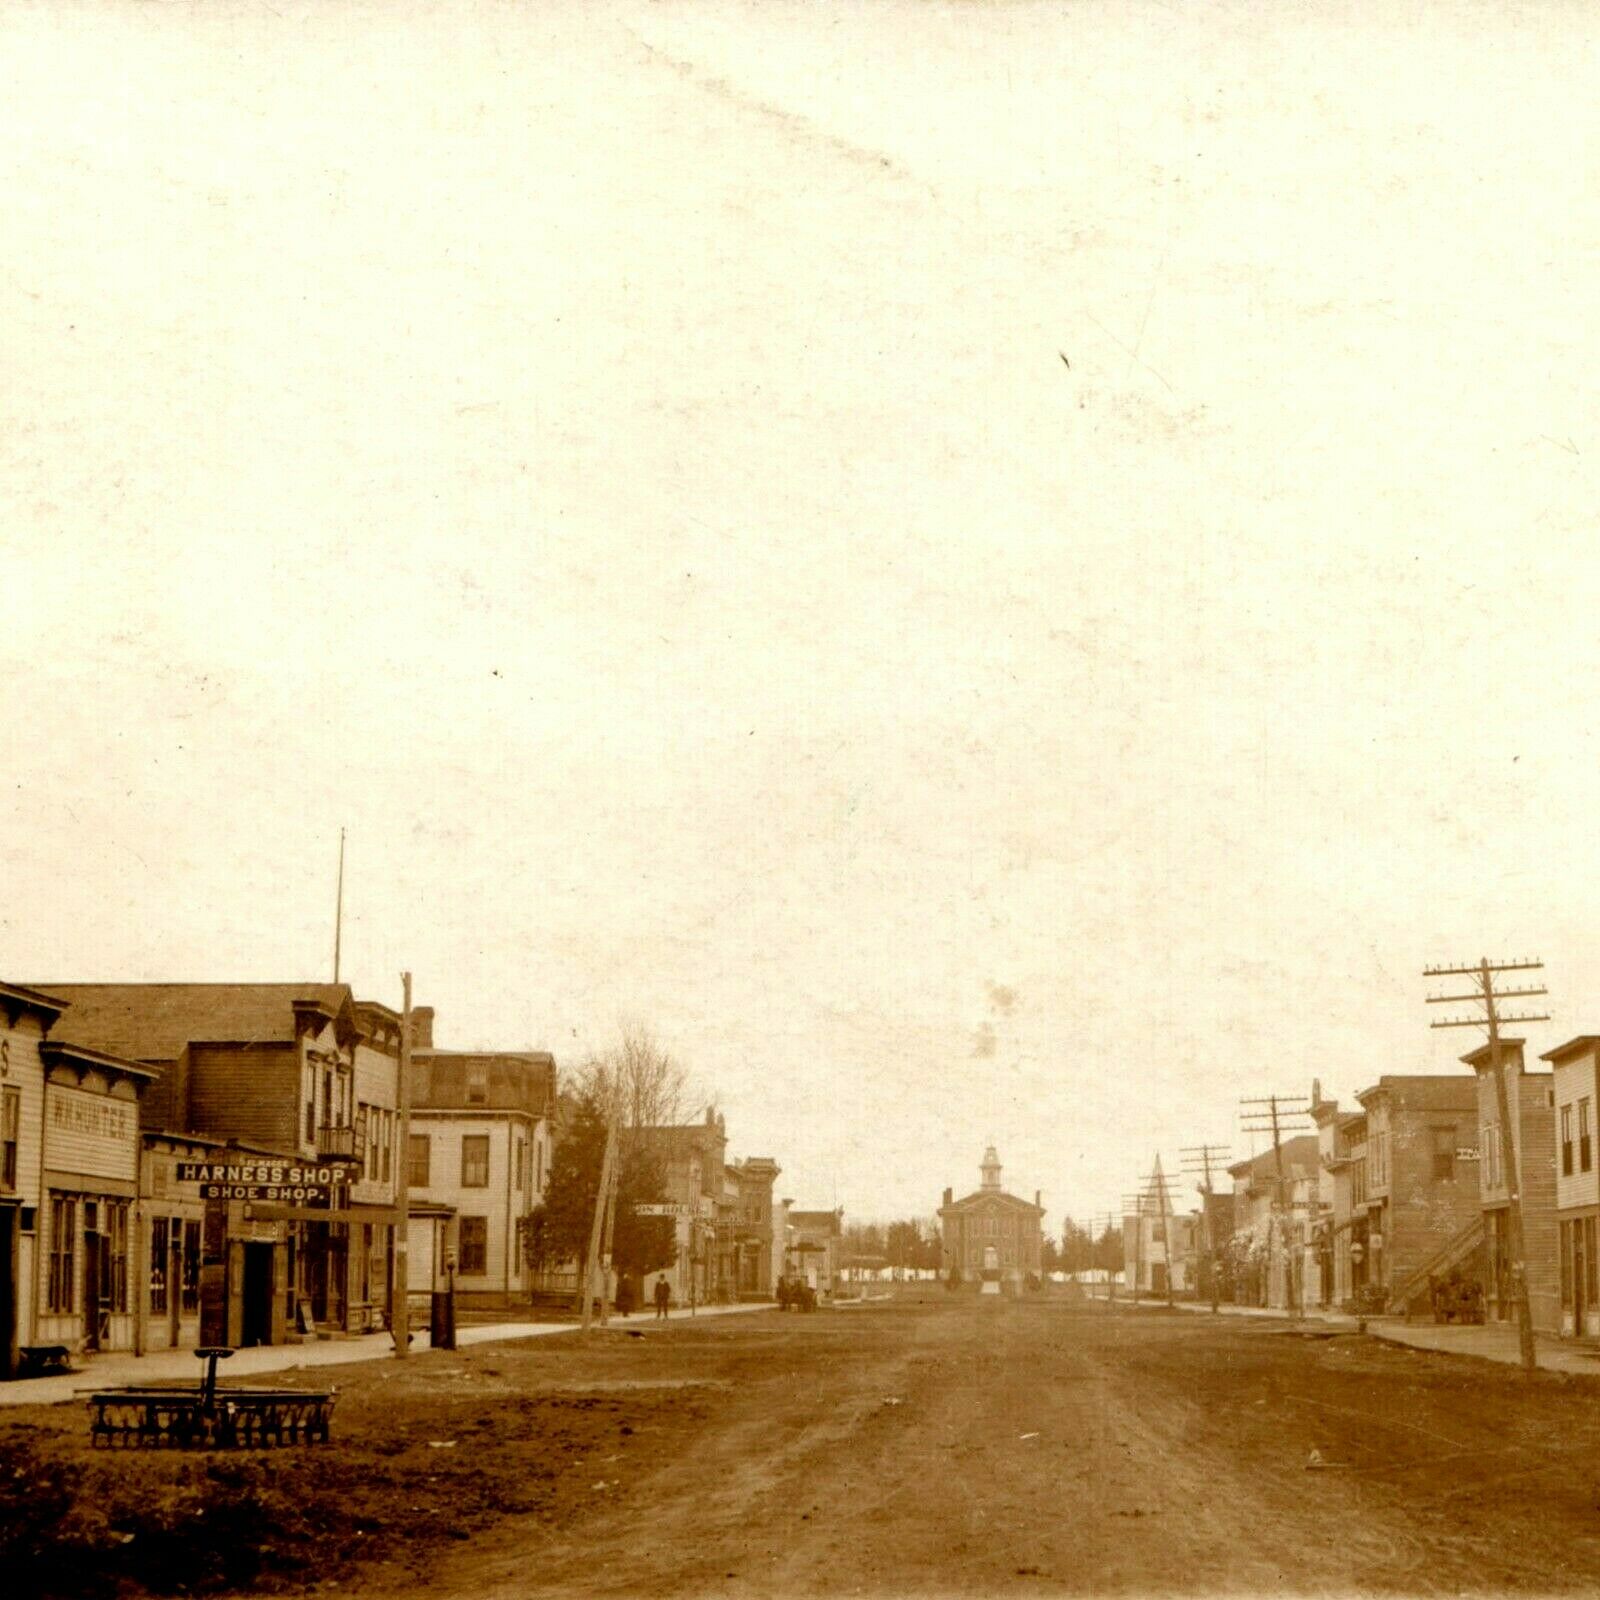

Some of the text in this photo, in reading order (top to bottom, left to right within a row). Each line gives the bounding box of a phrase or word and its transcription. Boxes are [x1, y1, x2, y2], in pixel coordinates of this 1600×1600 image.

[183, 1164, 284, 1182] HARNESS
[208, 1186, 324, 1200] SHOE SHOP.
